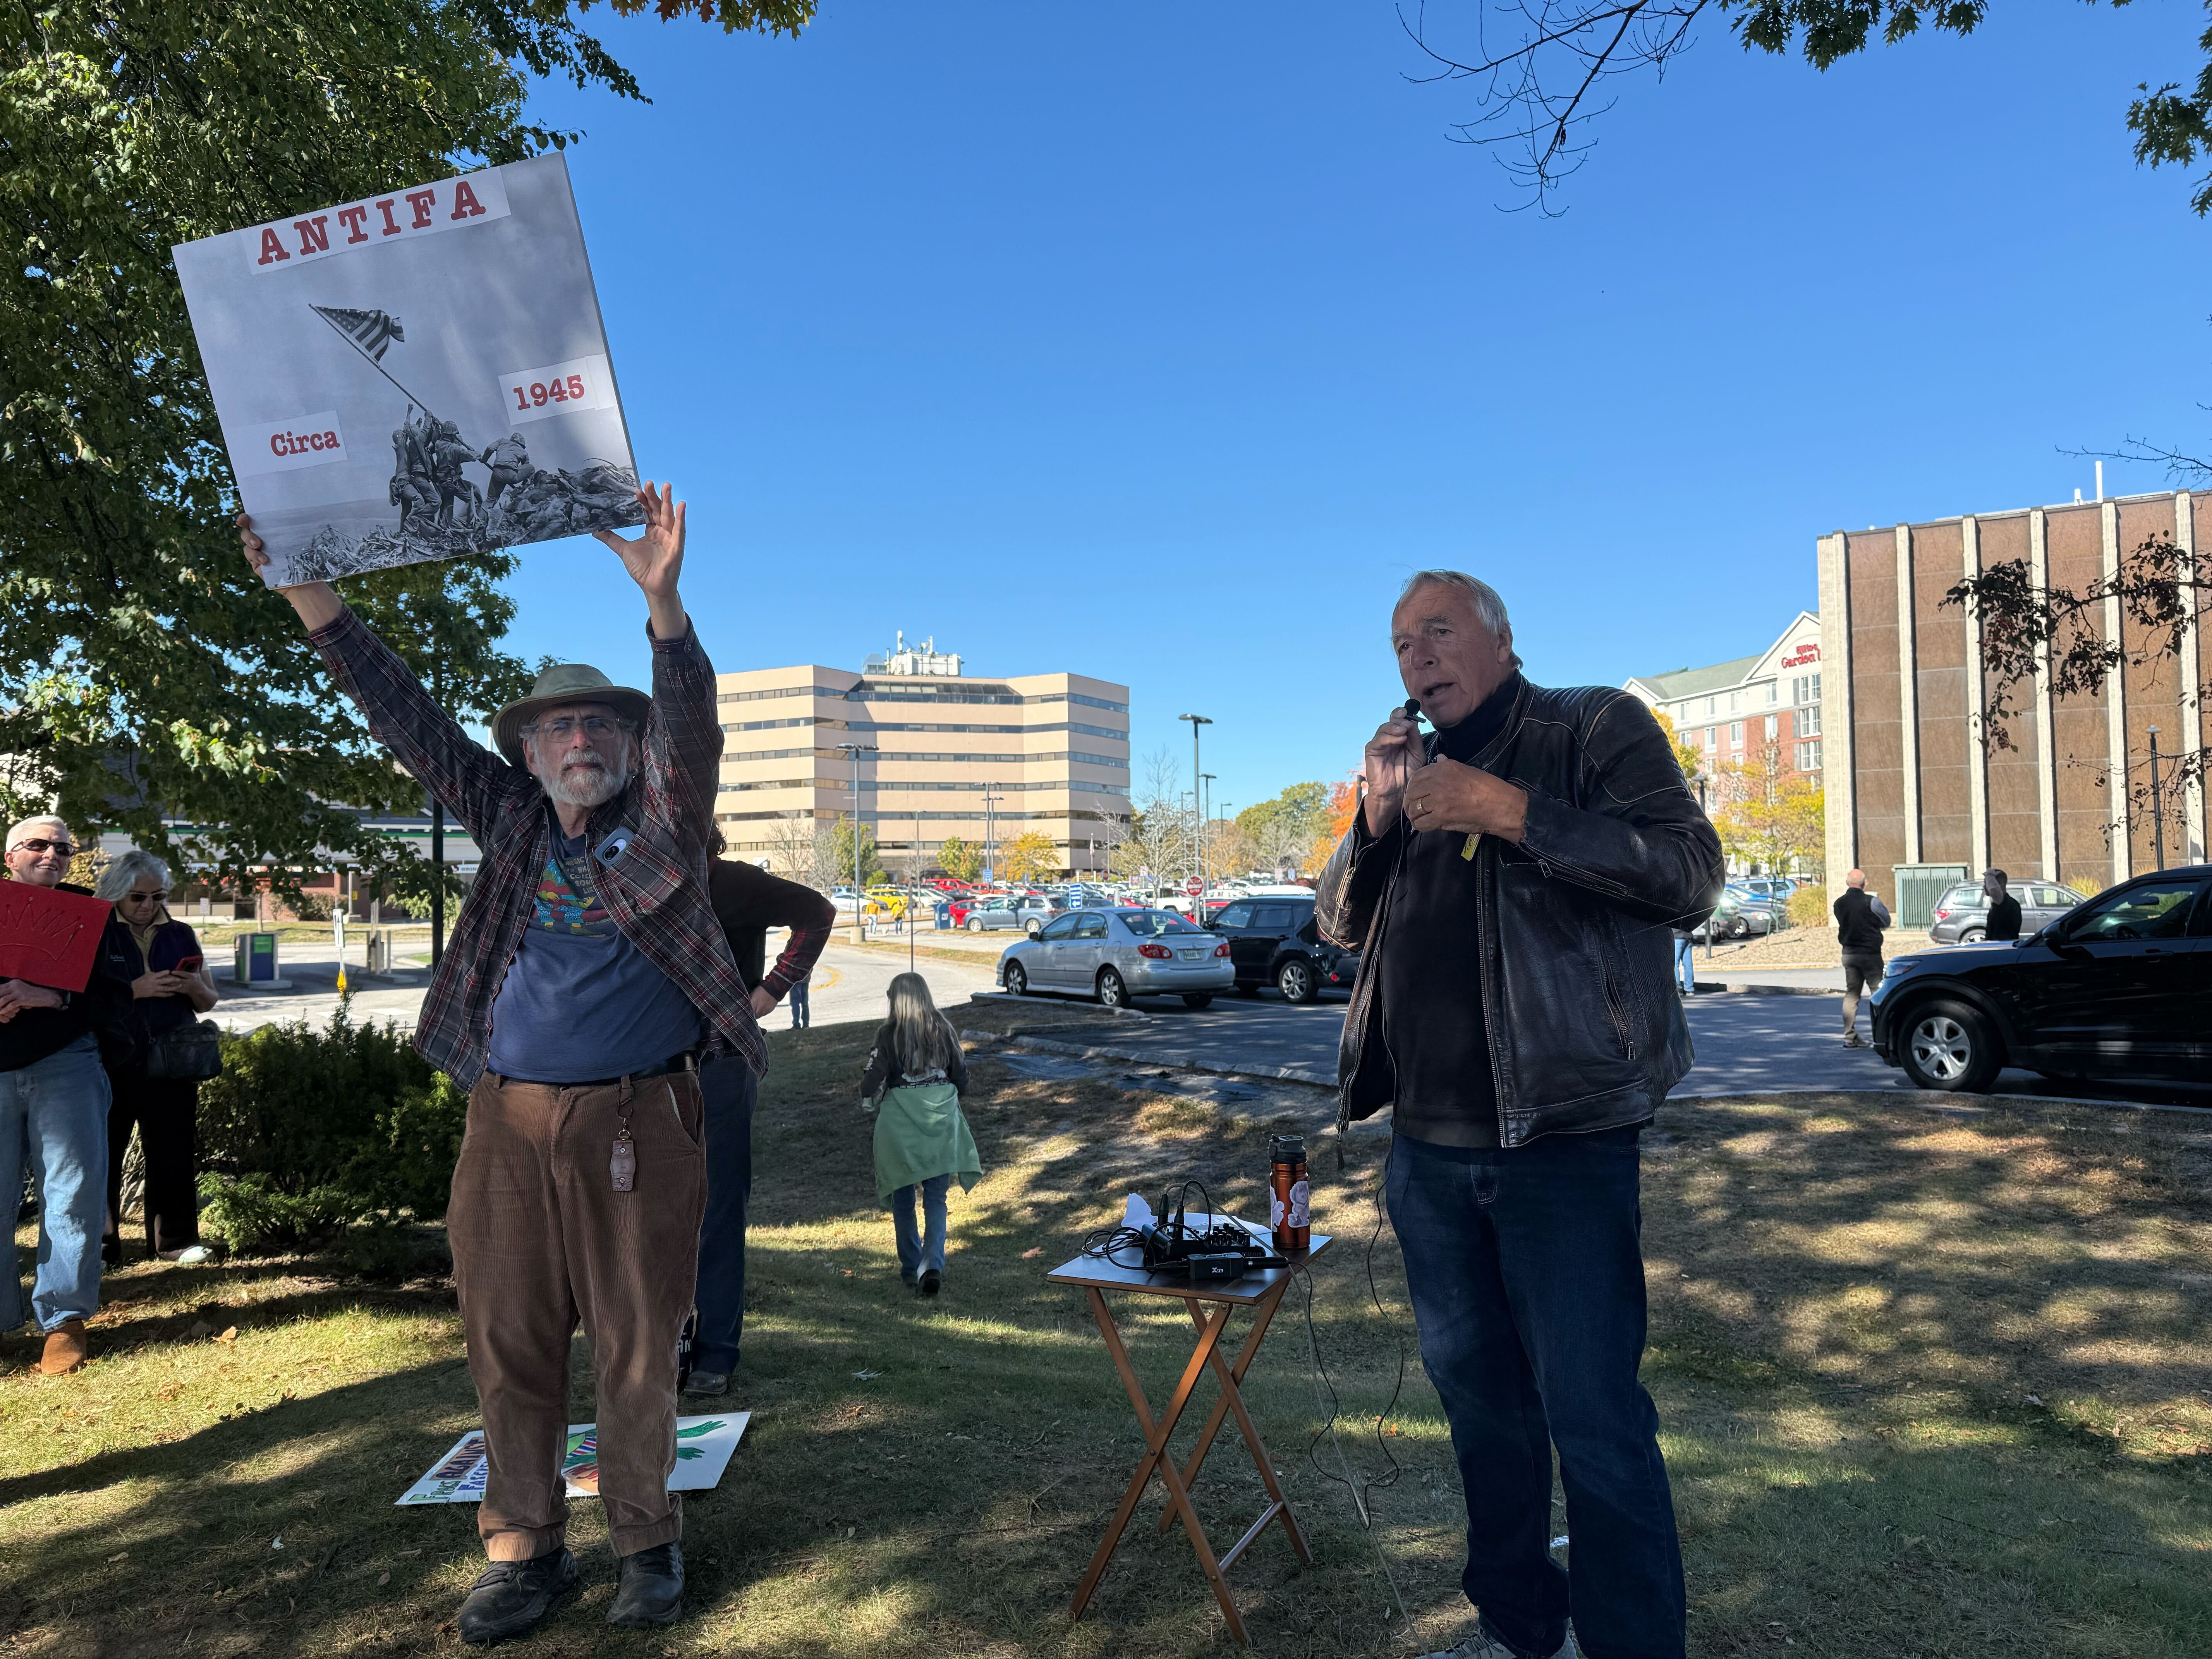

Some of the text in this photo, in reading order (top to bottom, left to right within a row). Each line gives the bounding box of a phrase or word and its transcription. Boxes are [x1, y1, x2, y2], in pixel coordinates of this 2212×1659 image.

[258, 181, 486, 265] ANTIFA
[513, 374, 585, 410] 1945
[270, 431, 341, 457] Circa
[1781, 654, 1816, 669] Garden
